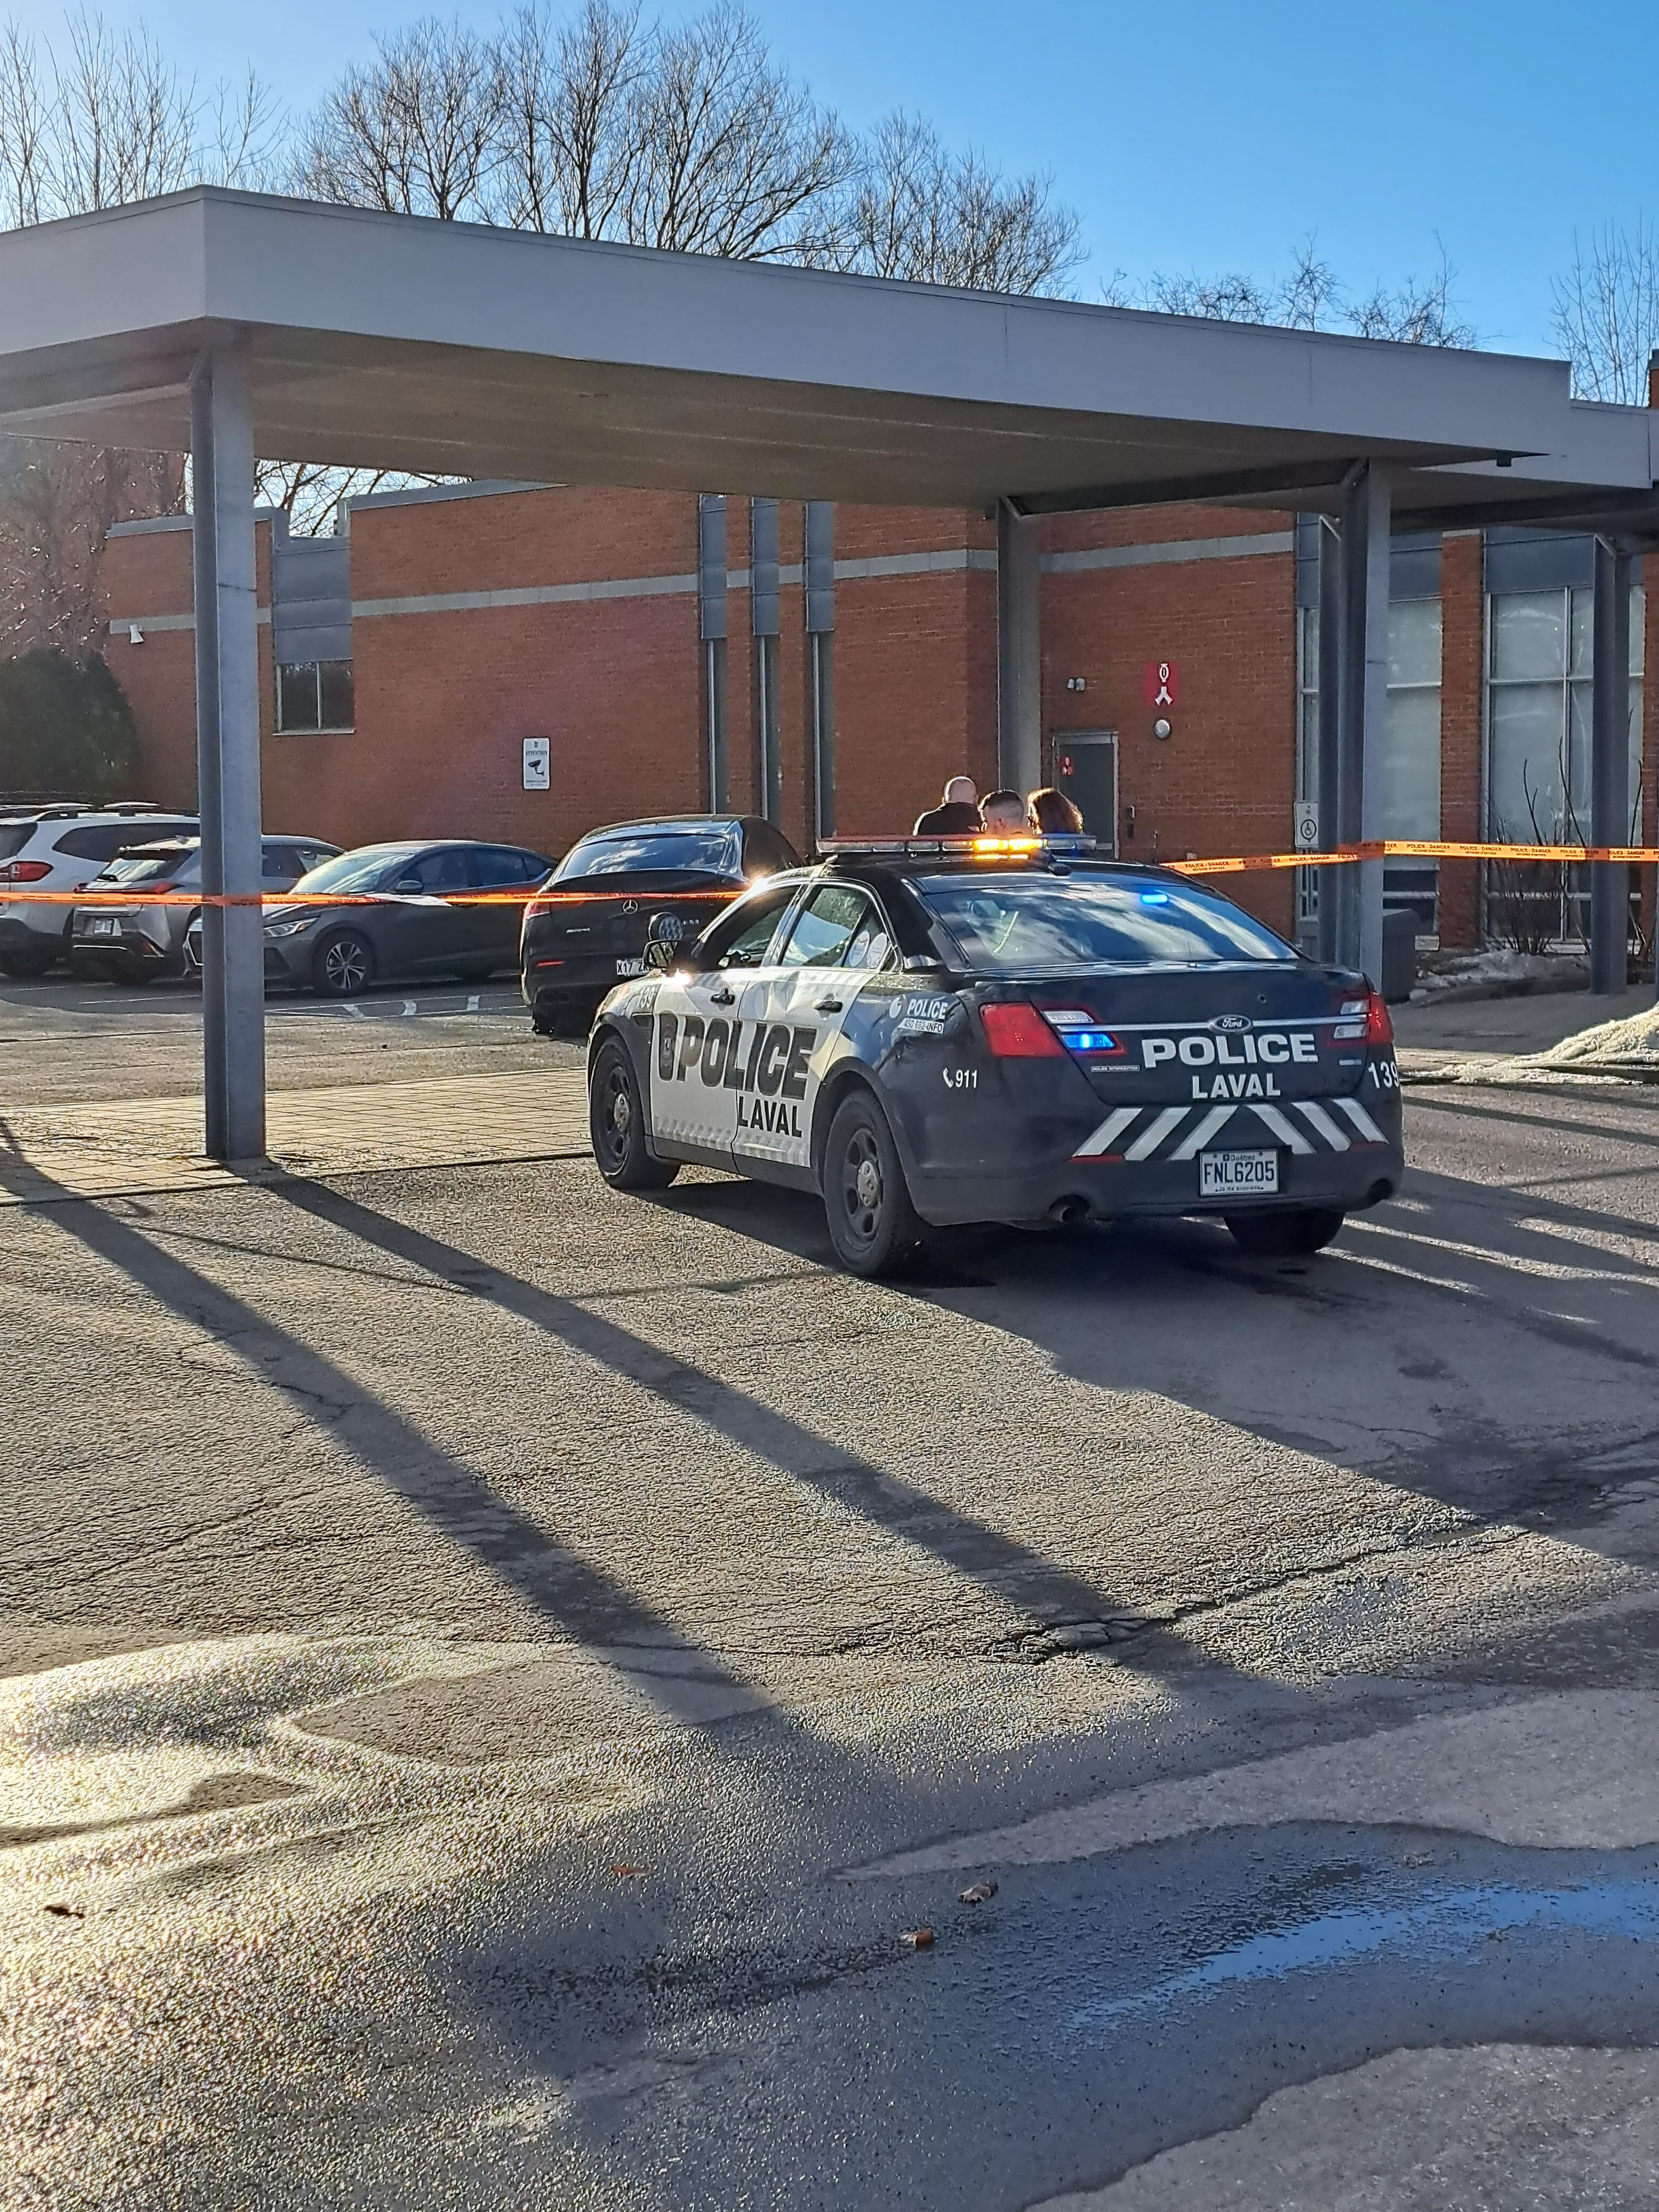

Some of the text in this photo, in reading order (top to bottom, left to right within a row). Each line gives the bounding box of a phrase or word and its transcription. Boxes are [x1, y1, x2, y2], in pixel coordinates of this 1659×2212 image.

[637, 985, 655, 1009] 139
[907, 998, 949, 1020] POLICE
[1222, 1018, 1243, 1028] Ford
[676, 1015, 818, 1100] POLICE
[1141, 1034, 1318, 1068] POLICE
[955, 1069, 977, 1088] 911
[1192, 1073, 1281, 1099] LAVAL
[1368, 1061, 1399, 1088] 139
[738, 1096, 802, 1138] LAVAL
[1204, 1161, 1274, 1184] FNL6205
